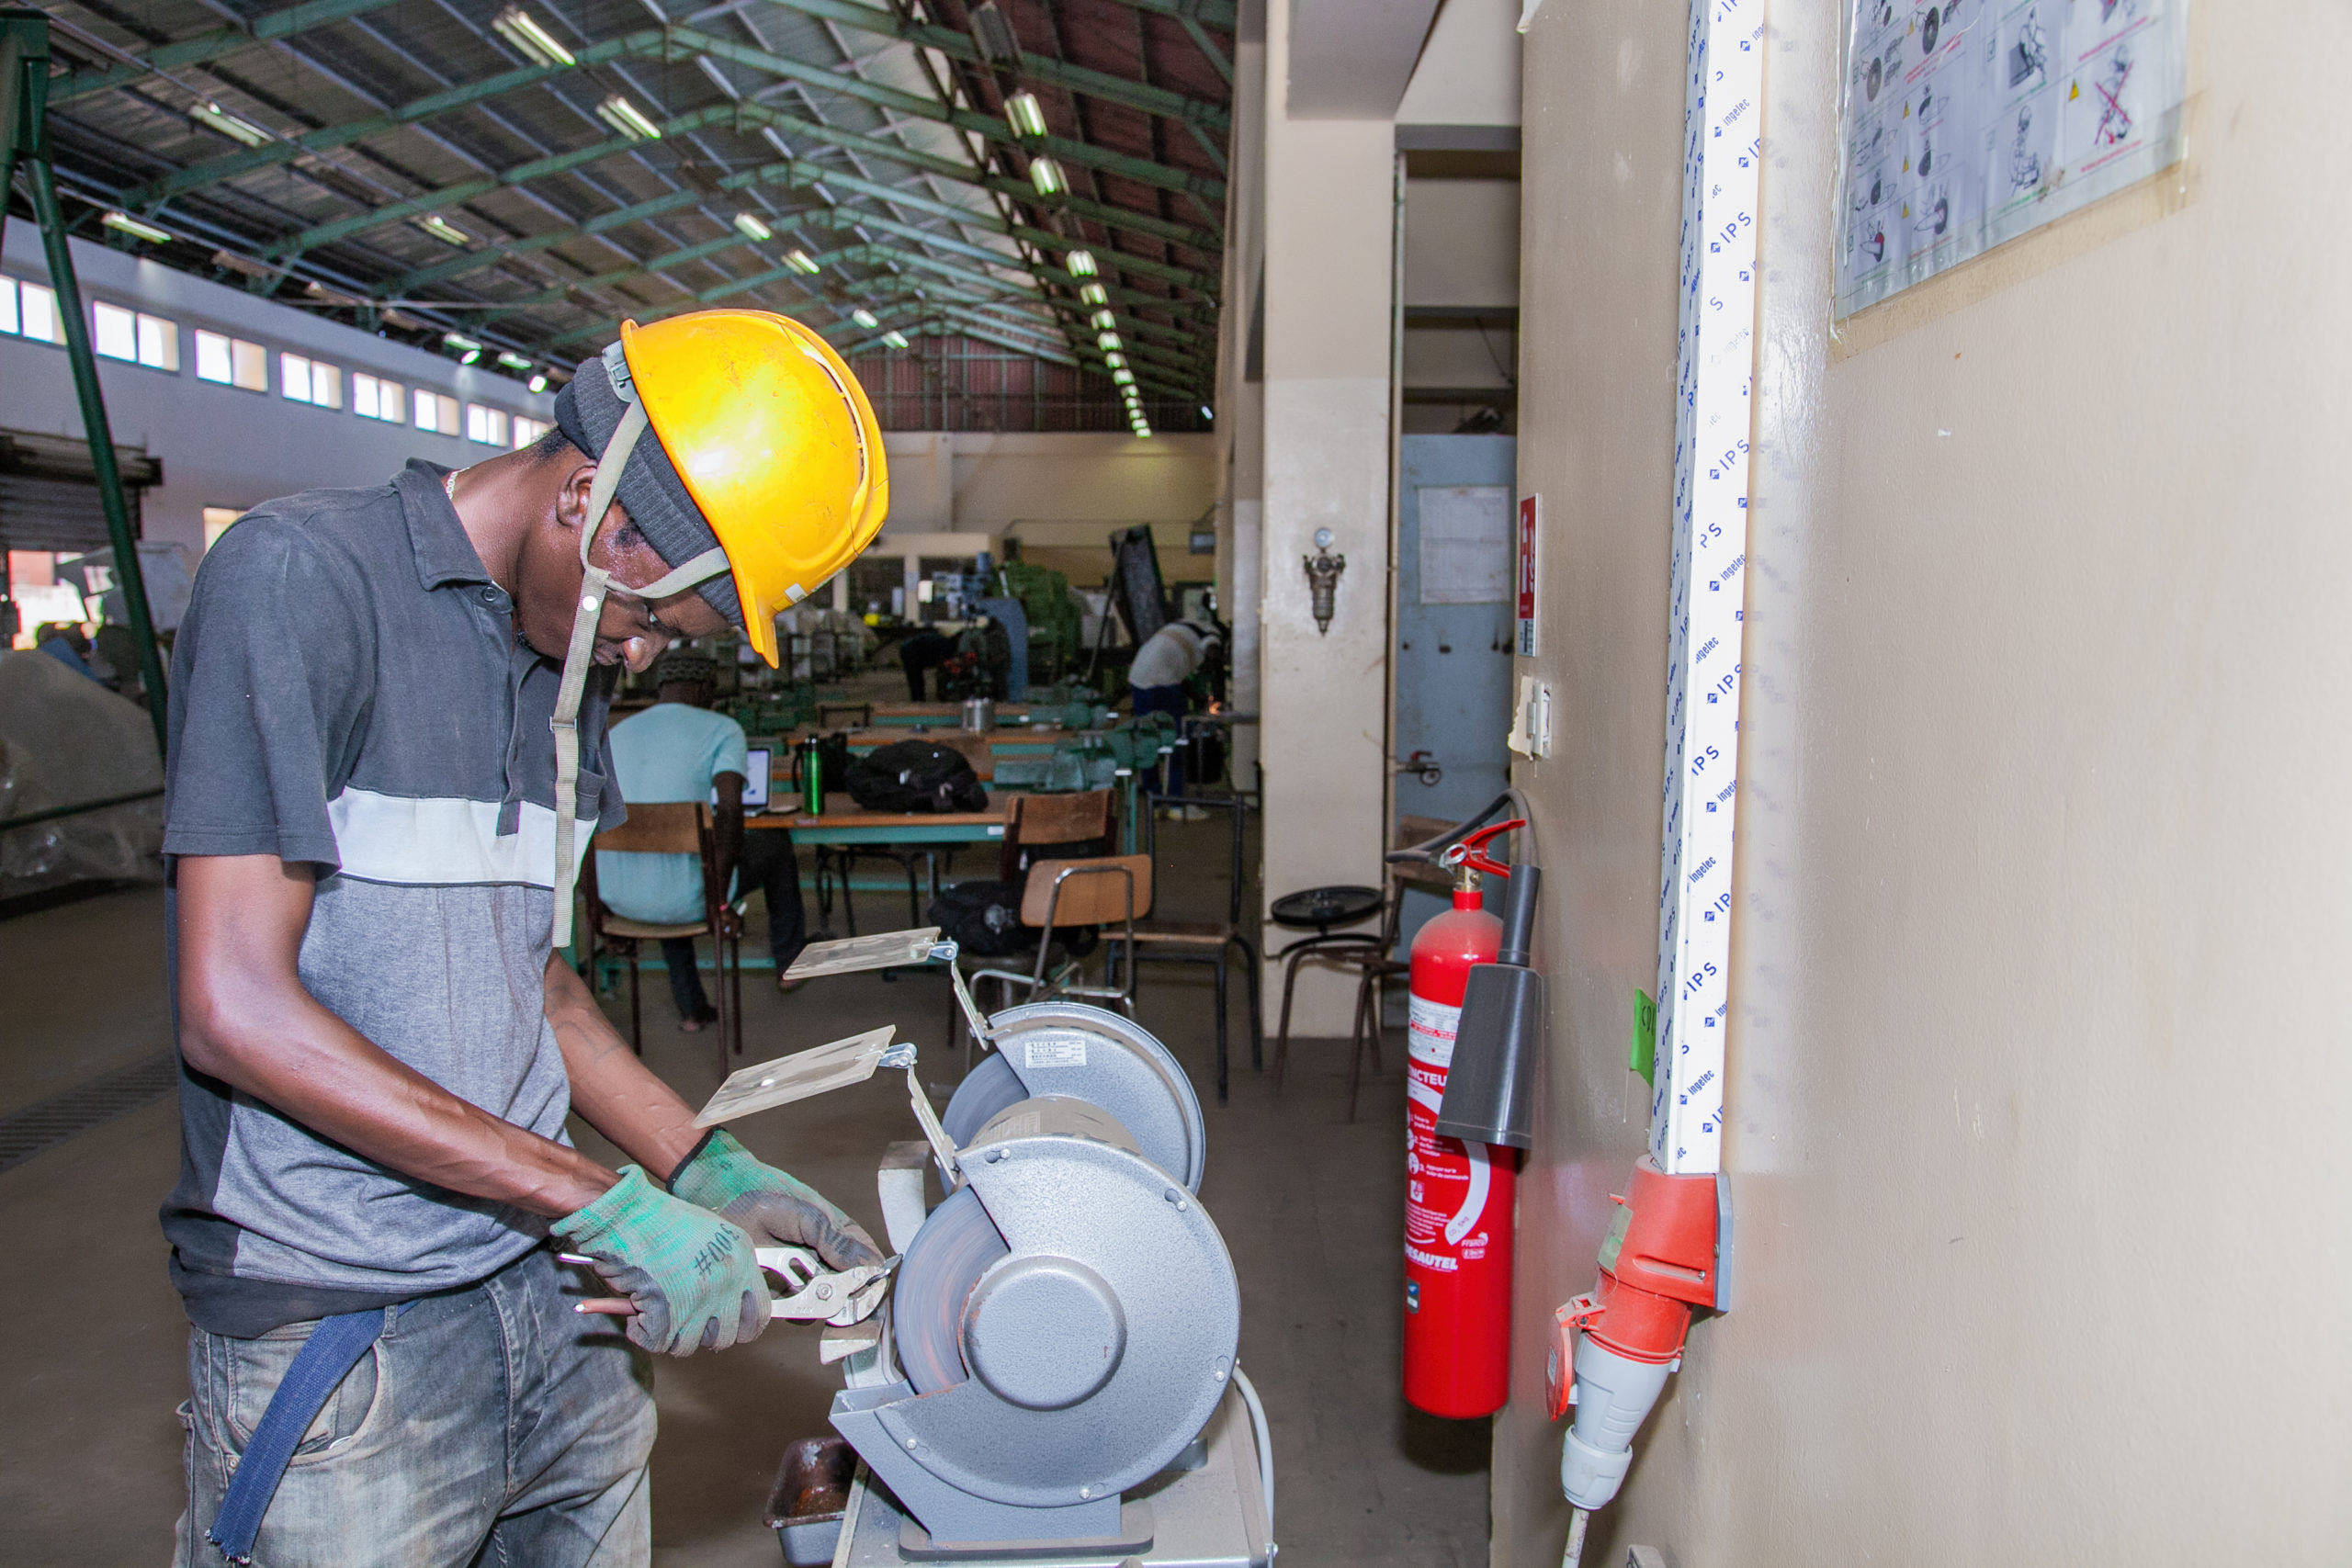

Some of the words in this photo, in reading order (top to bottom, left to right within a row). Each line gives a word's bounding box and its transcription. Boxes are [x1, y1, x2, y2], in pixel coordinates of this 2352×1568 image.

[1723, 98, 1750, 127] ingelec
[1720, 211, 1751, 243] IPS
[1720, 439, 1750, 470] IPS
[1691, 745, 1720, 776] IPS
[1689, 856, 1716, 883] ingelec
[1686, 962, 1717, 992] IPS
[1687, 1069, 1715, 1096] ingelec
